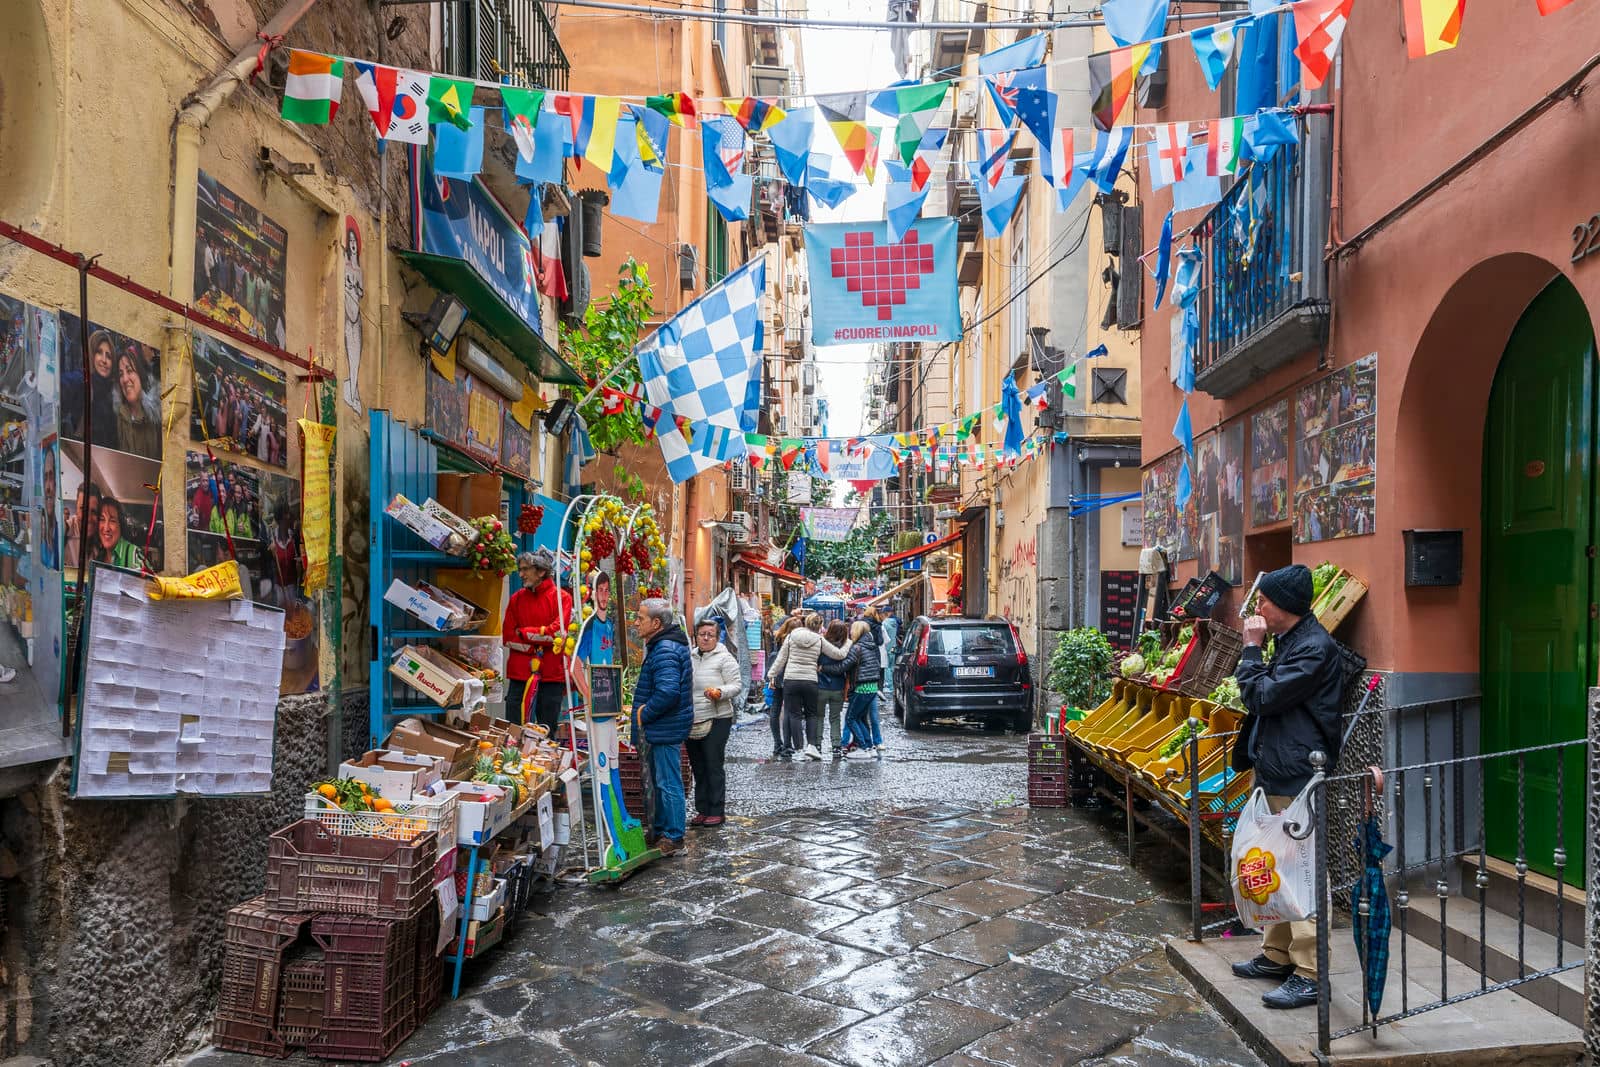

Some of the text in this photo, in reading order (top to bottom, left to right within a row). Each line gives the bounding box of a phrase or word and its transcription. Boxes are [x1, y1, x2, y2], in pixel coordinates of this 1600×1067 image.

[469, 198, 505, 274] NAPOLI
[1571, 212, 1600, 263] 22
[834, 323, 937, 340] #CUOREDINAPOLI
[416, 671, 447, 696] Ruchey
